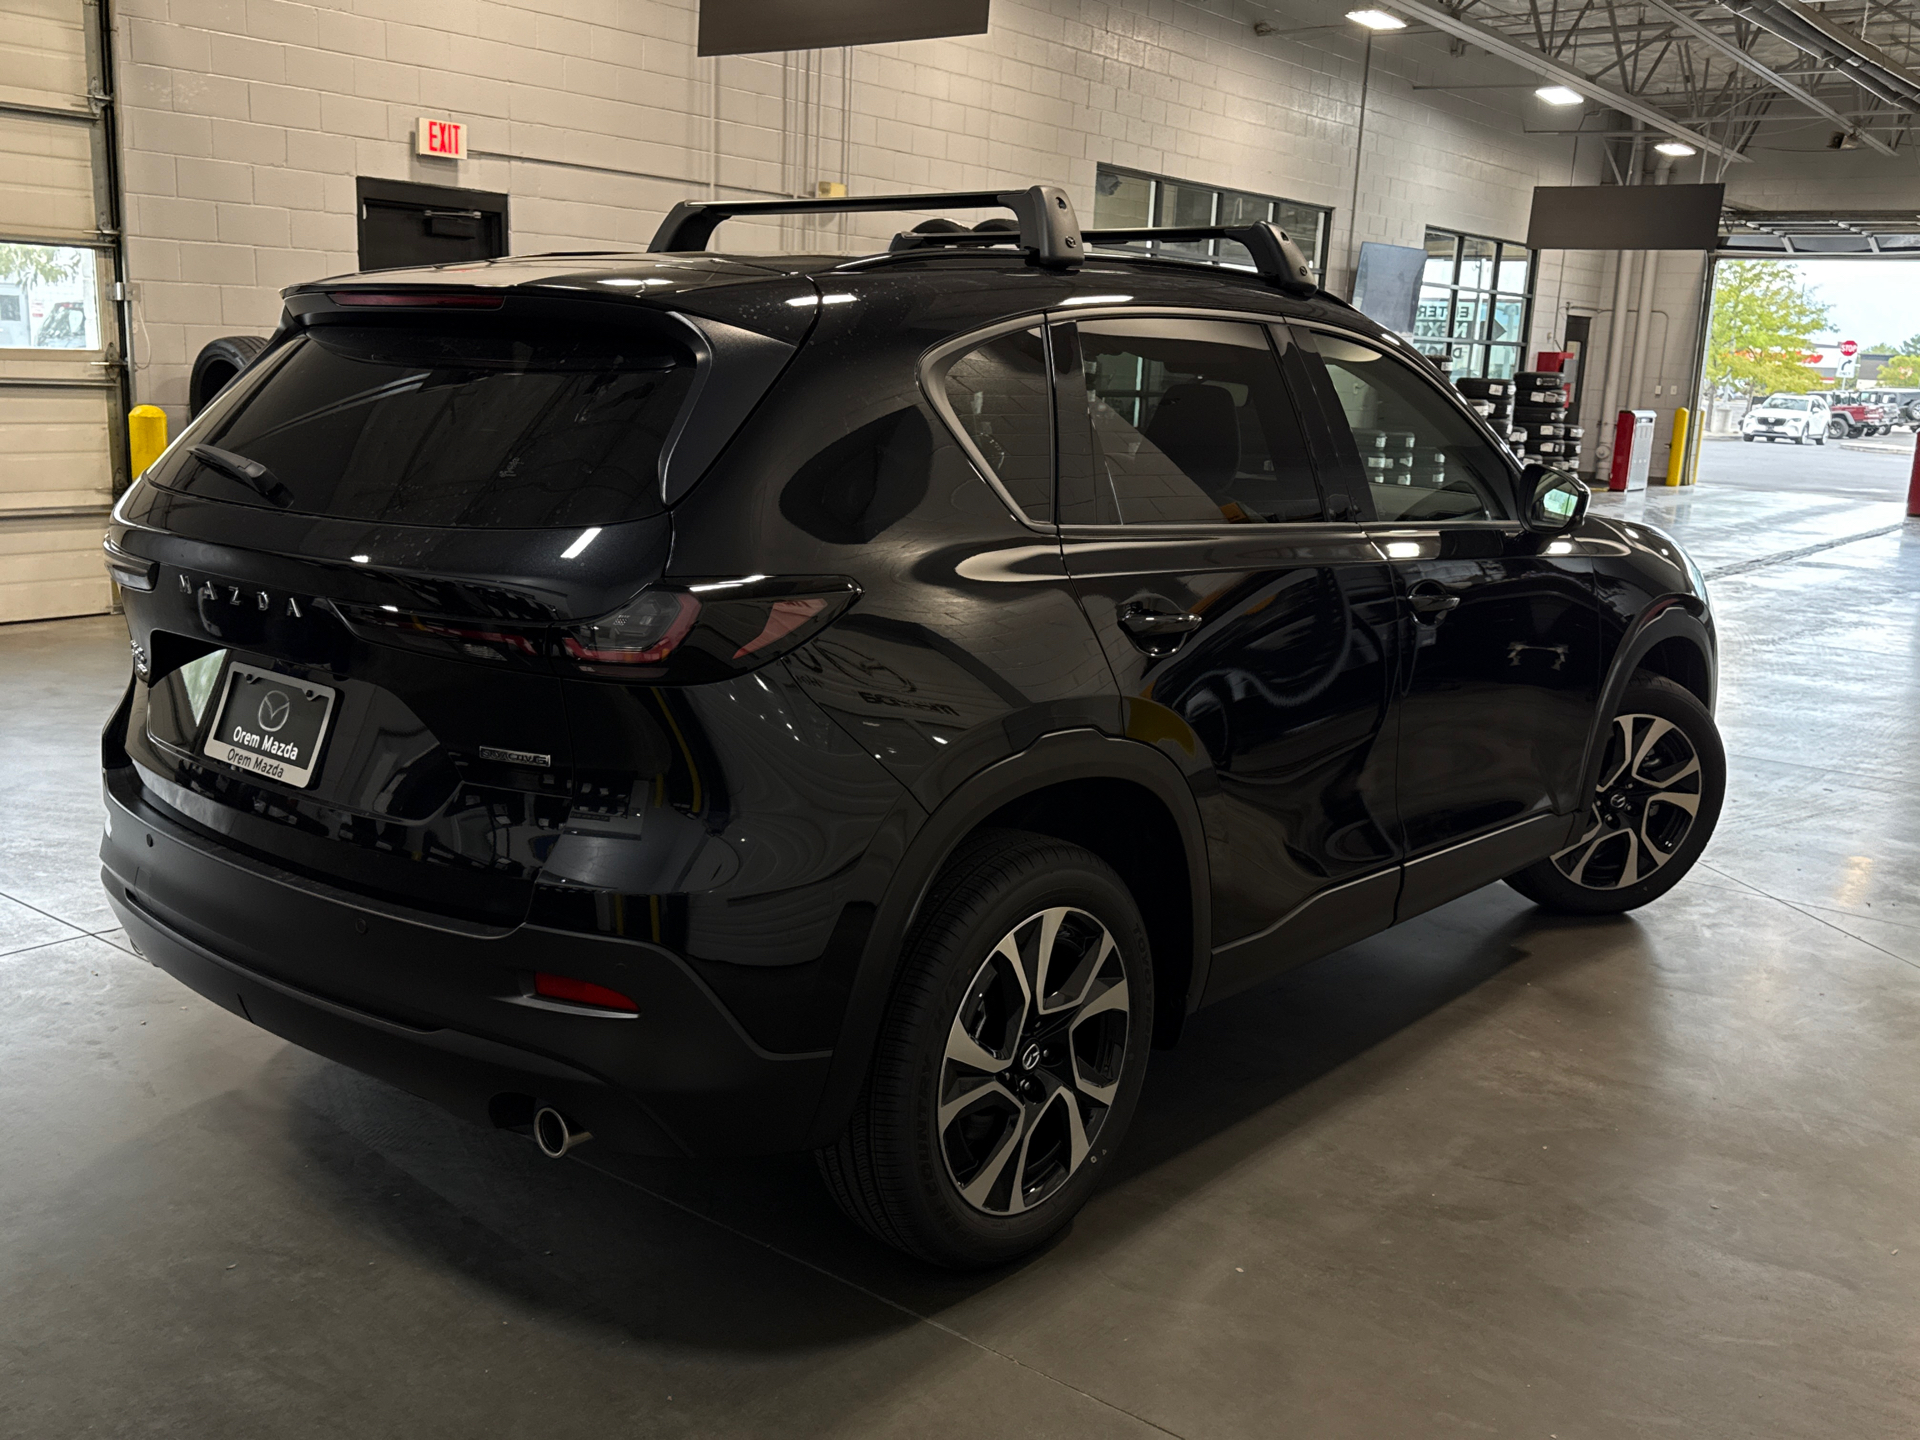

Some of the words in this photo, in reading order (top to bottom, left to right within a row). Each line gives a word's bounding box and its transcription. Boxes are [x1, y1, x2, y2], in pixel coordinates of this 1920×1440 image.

[428, 121, 461, 155] EXIT
[1841, 344, 1857, 352] STOP
[179, 574, 302, 618] MAZDA
[233, 725, 260, 749] Orem
[261, 734, 299, 761] Mazda
[227, 748, 251, 768] Orem
[252, 756, 285, 779] Mazda
